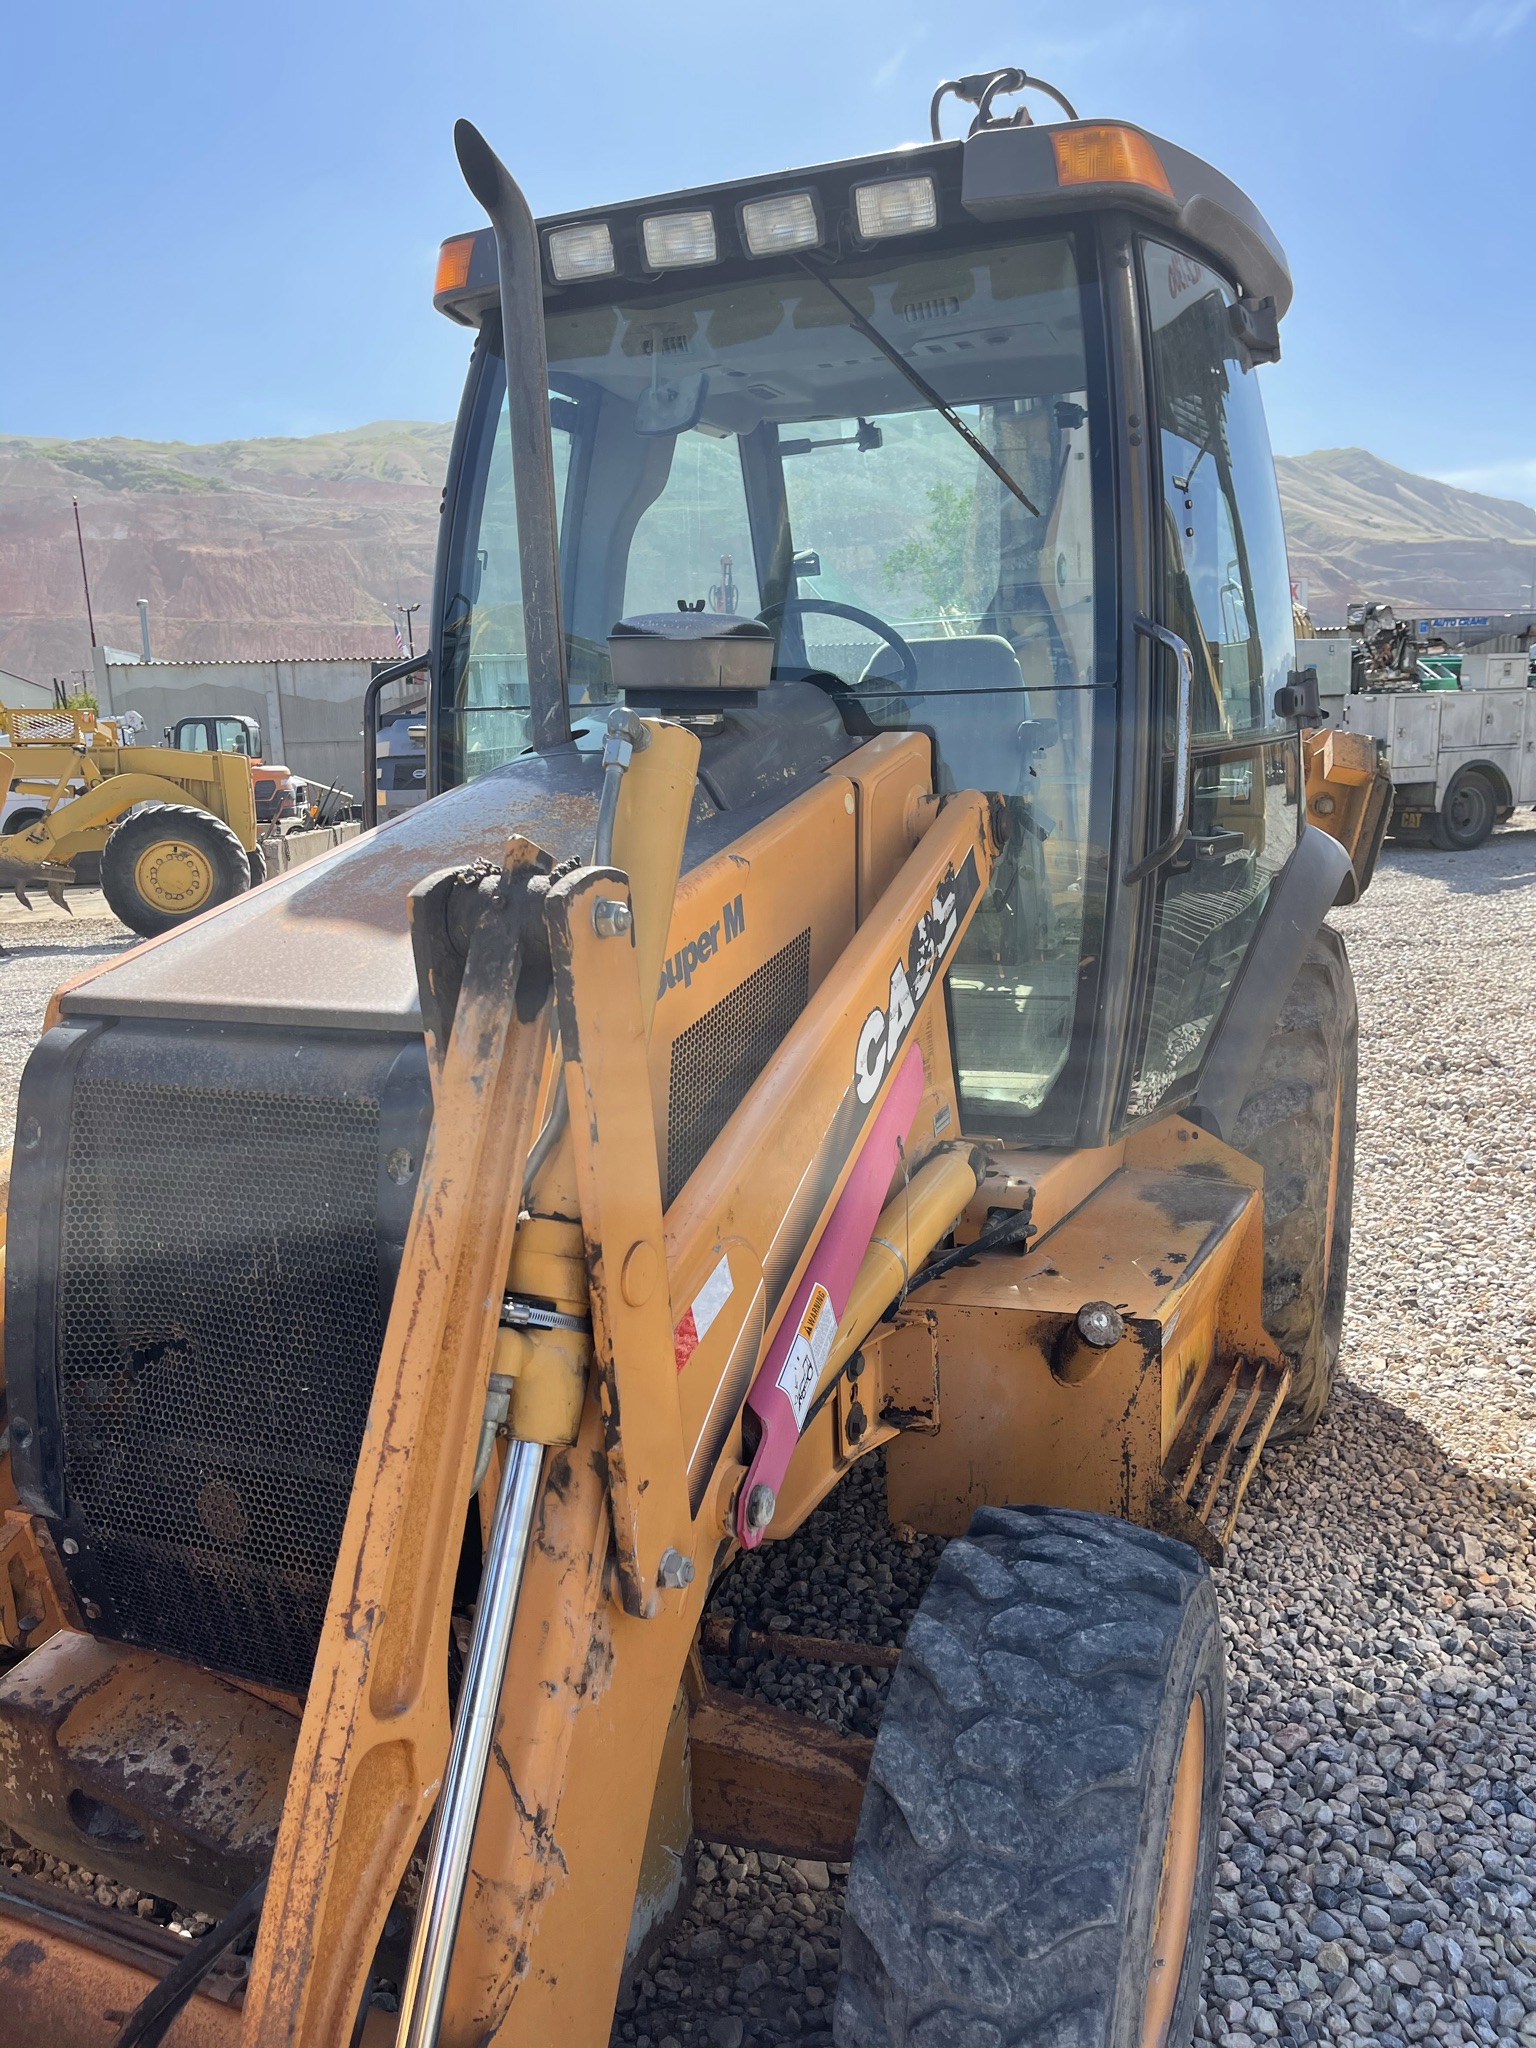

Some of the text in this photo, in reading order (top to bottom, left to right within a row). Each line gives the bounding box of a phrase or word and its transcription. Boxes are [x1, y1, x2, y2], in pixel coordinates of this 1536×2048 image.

[1432, 617, 1457, 627] AUTO
[1401, 812, 1422, 829] CAT
[722, 892, 746, 945] M
[807, 1290, 826, 1327] WARNING
